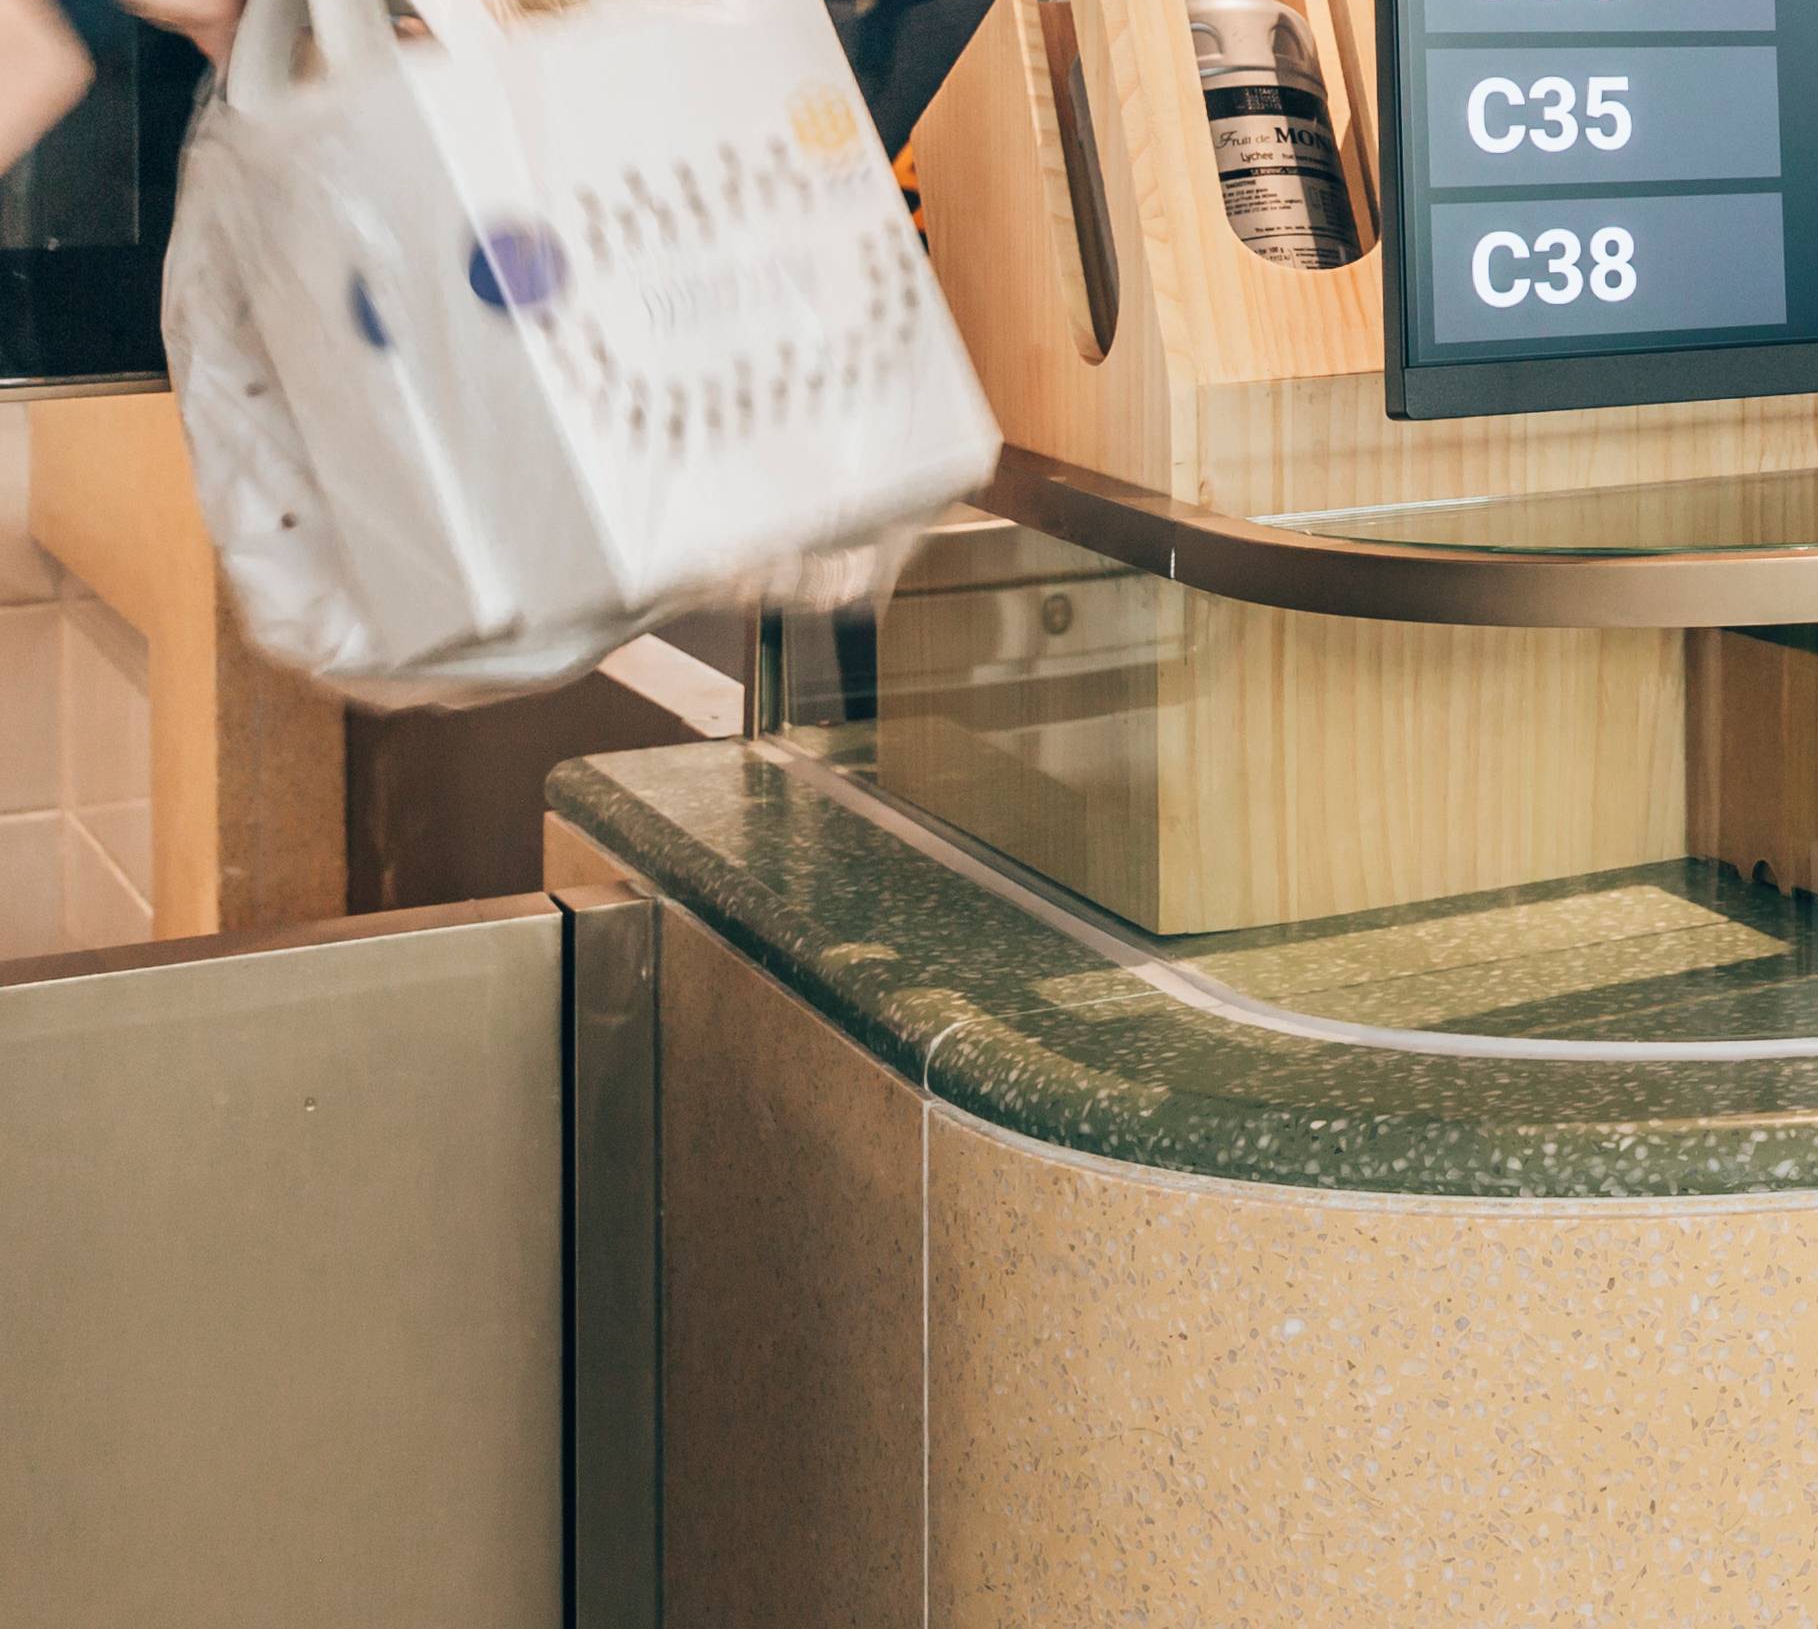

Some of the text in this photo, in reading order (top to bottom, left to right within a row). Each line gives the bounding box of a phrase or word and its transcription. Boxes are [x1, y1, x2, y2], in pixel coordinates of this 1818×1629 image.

[1467, 76, 1632, 154] C35
[1241, 151, 1274, 164] Lychee
[1472, 226, 1637, 308] C38
